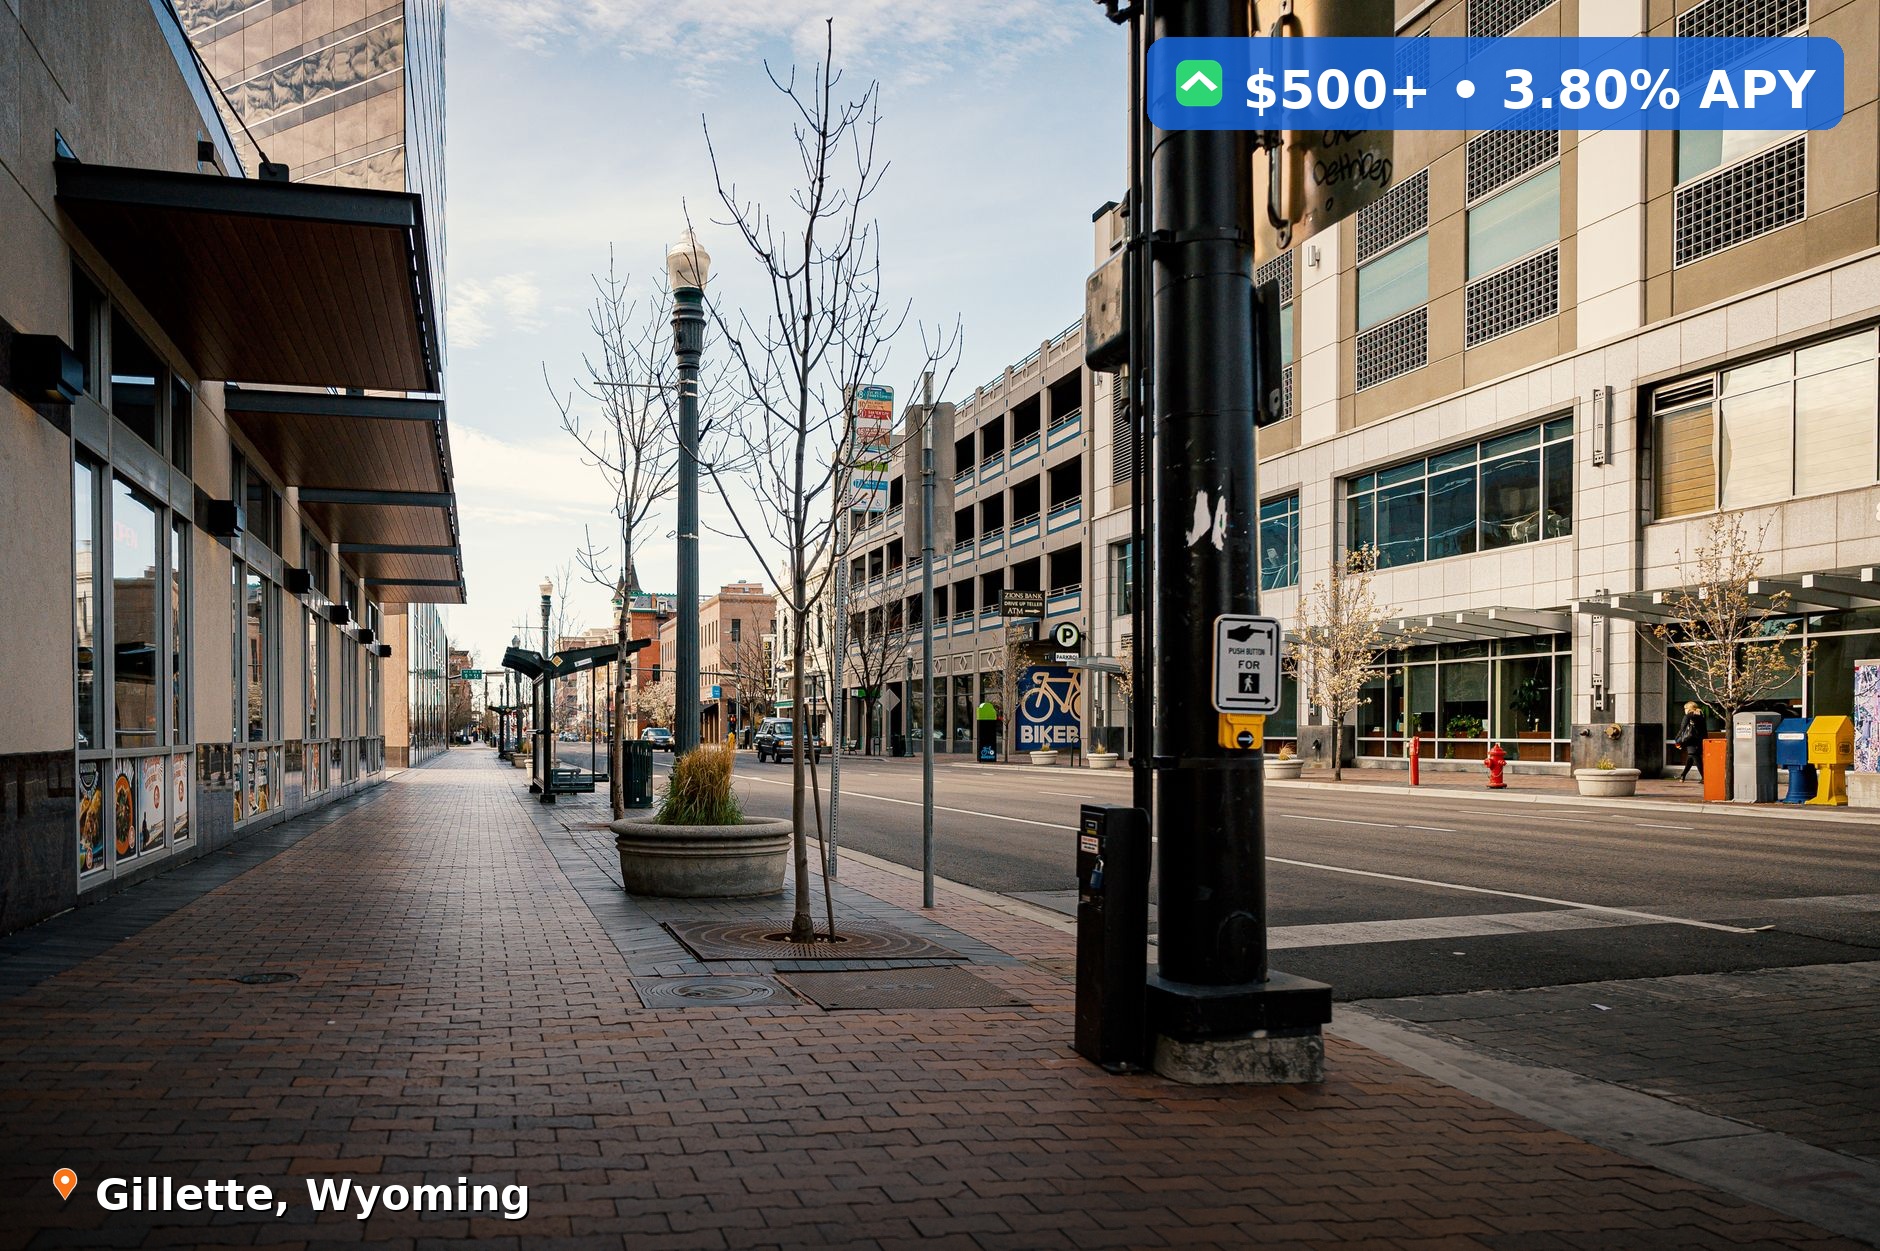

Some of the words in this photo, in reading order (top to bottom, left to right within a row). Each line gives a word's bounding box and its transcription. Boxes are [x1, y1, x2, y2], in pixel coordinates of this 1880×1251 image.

[1007, 607, 1024, 615] ATM
[1061, 627, 1074, 643] P
[1238, 660, 1260, 670] FOR
